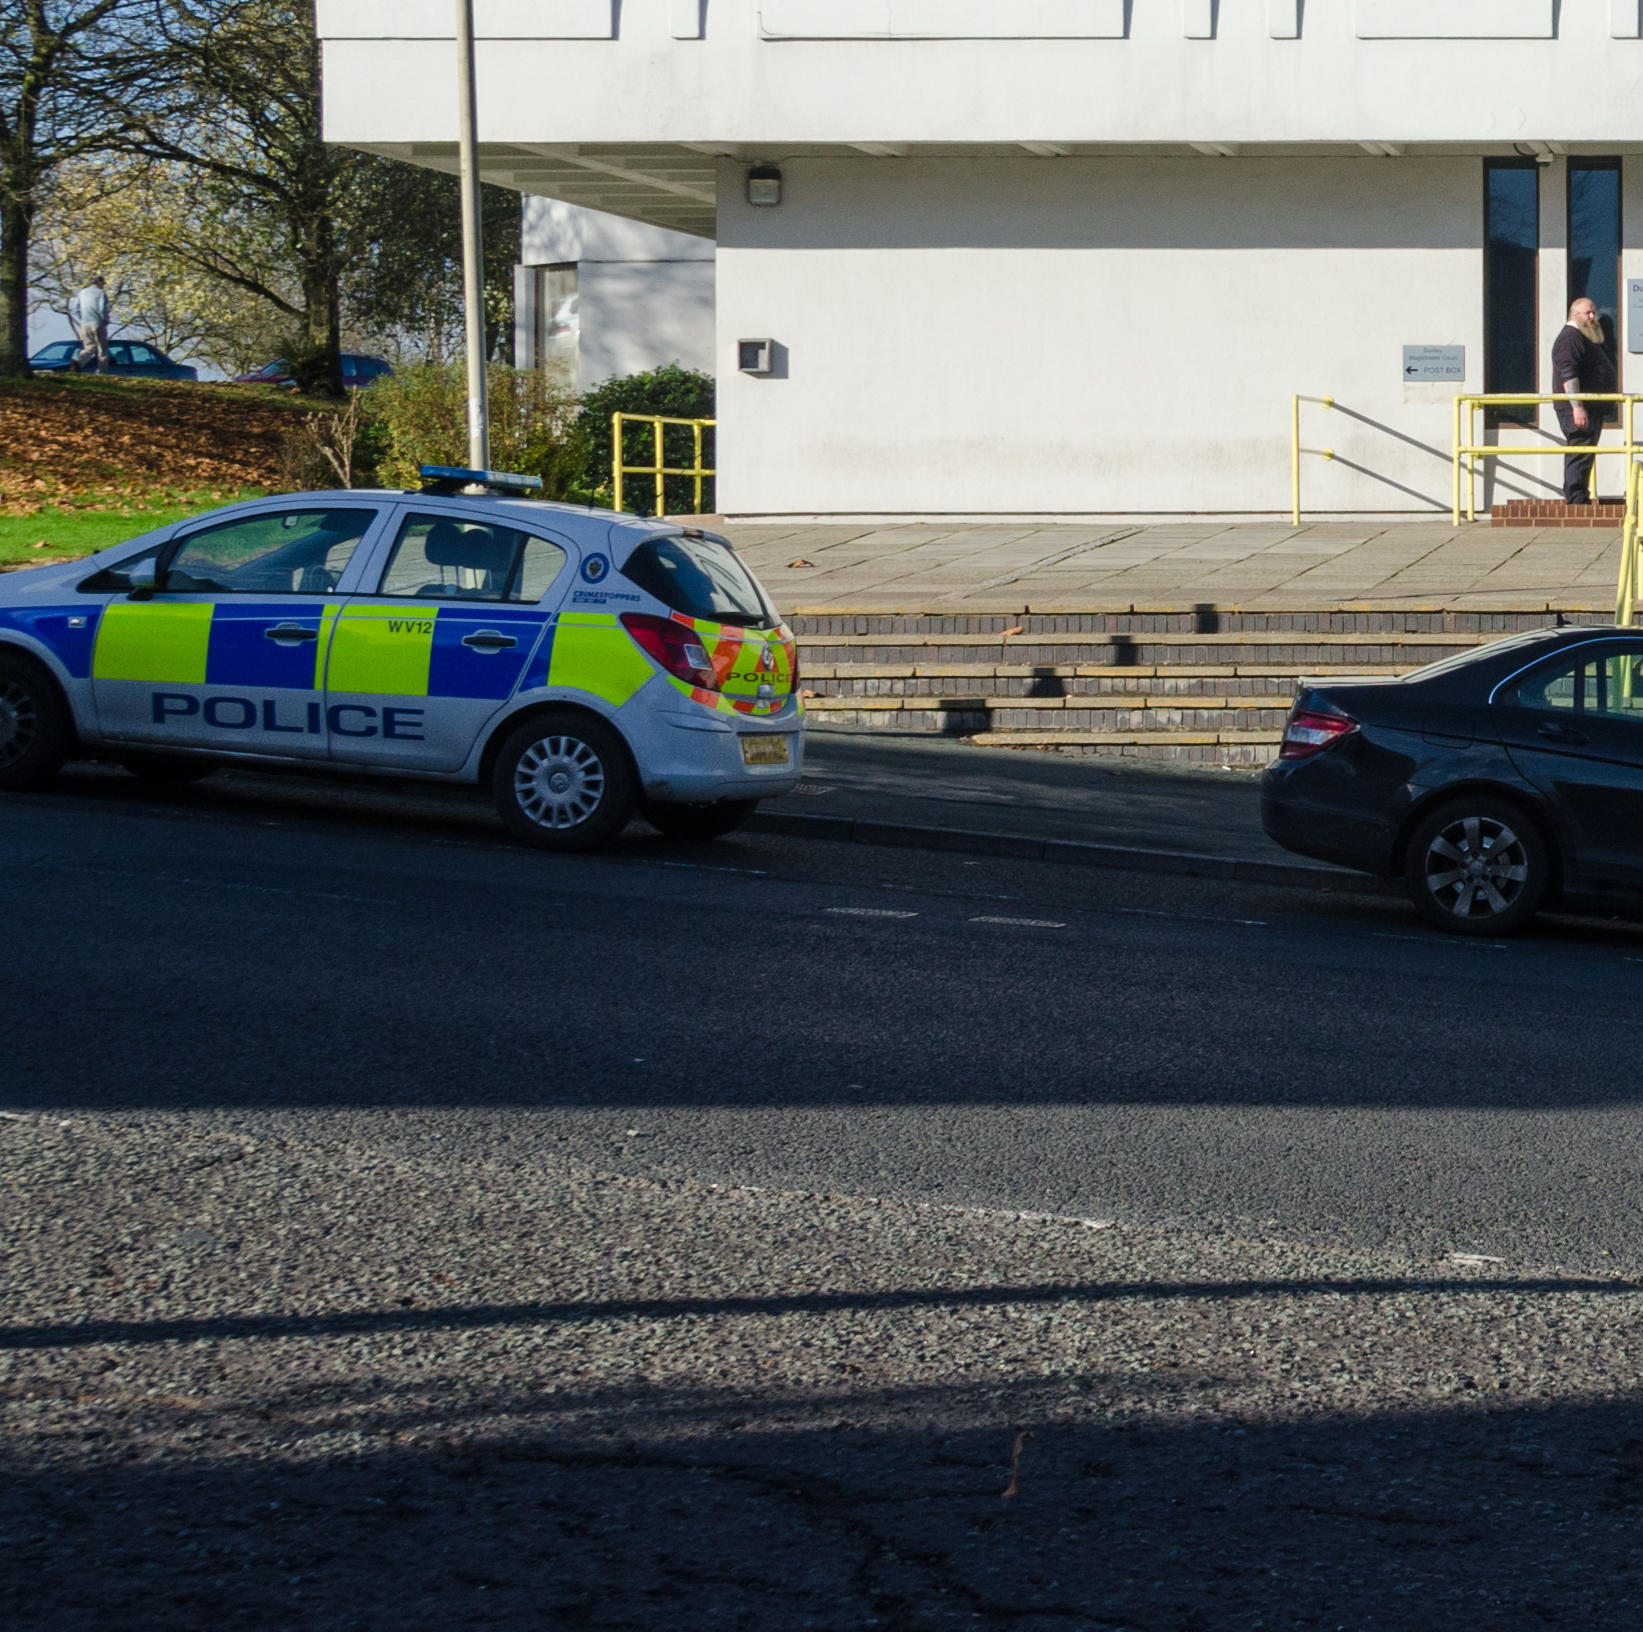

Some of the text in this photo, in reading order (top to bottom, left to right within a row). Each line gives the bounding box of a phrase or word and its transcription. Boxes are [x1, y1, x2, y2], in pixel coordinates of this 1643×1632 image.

[1423, 366, 1462, 374] POST BOX
[573, 590, 641, 602] CRIMESTOPPERS
[388, 620, 432, 634] WV12
[726, 672, 792, 683] POLICE
[151, 691, 425, 741] POLICE
